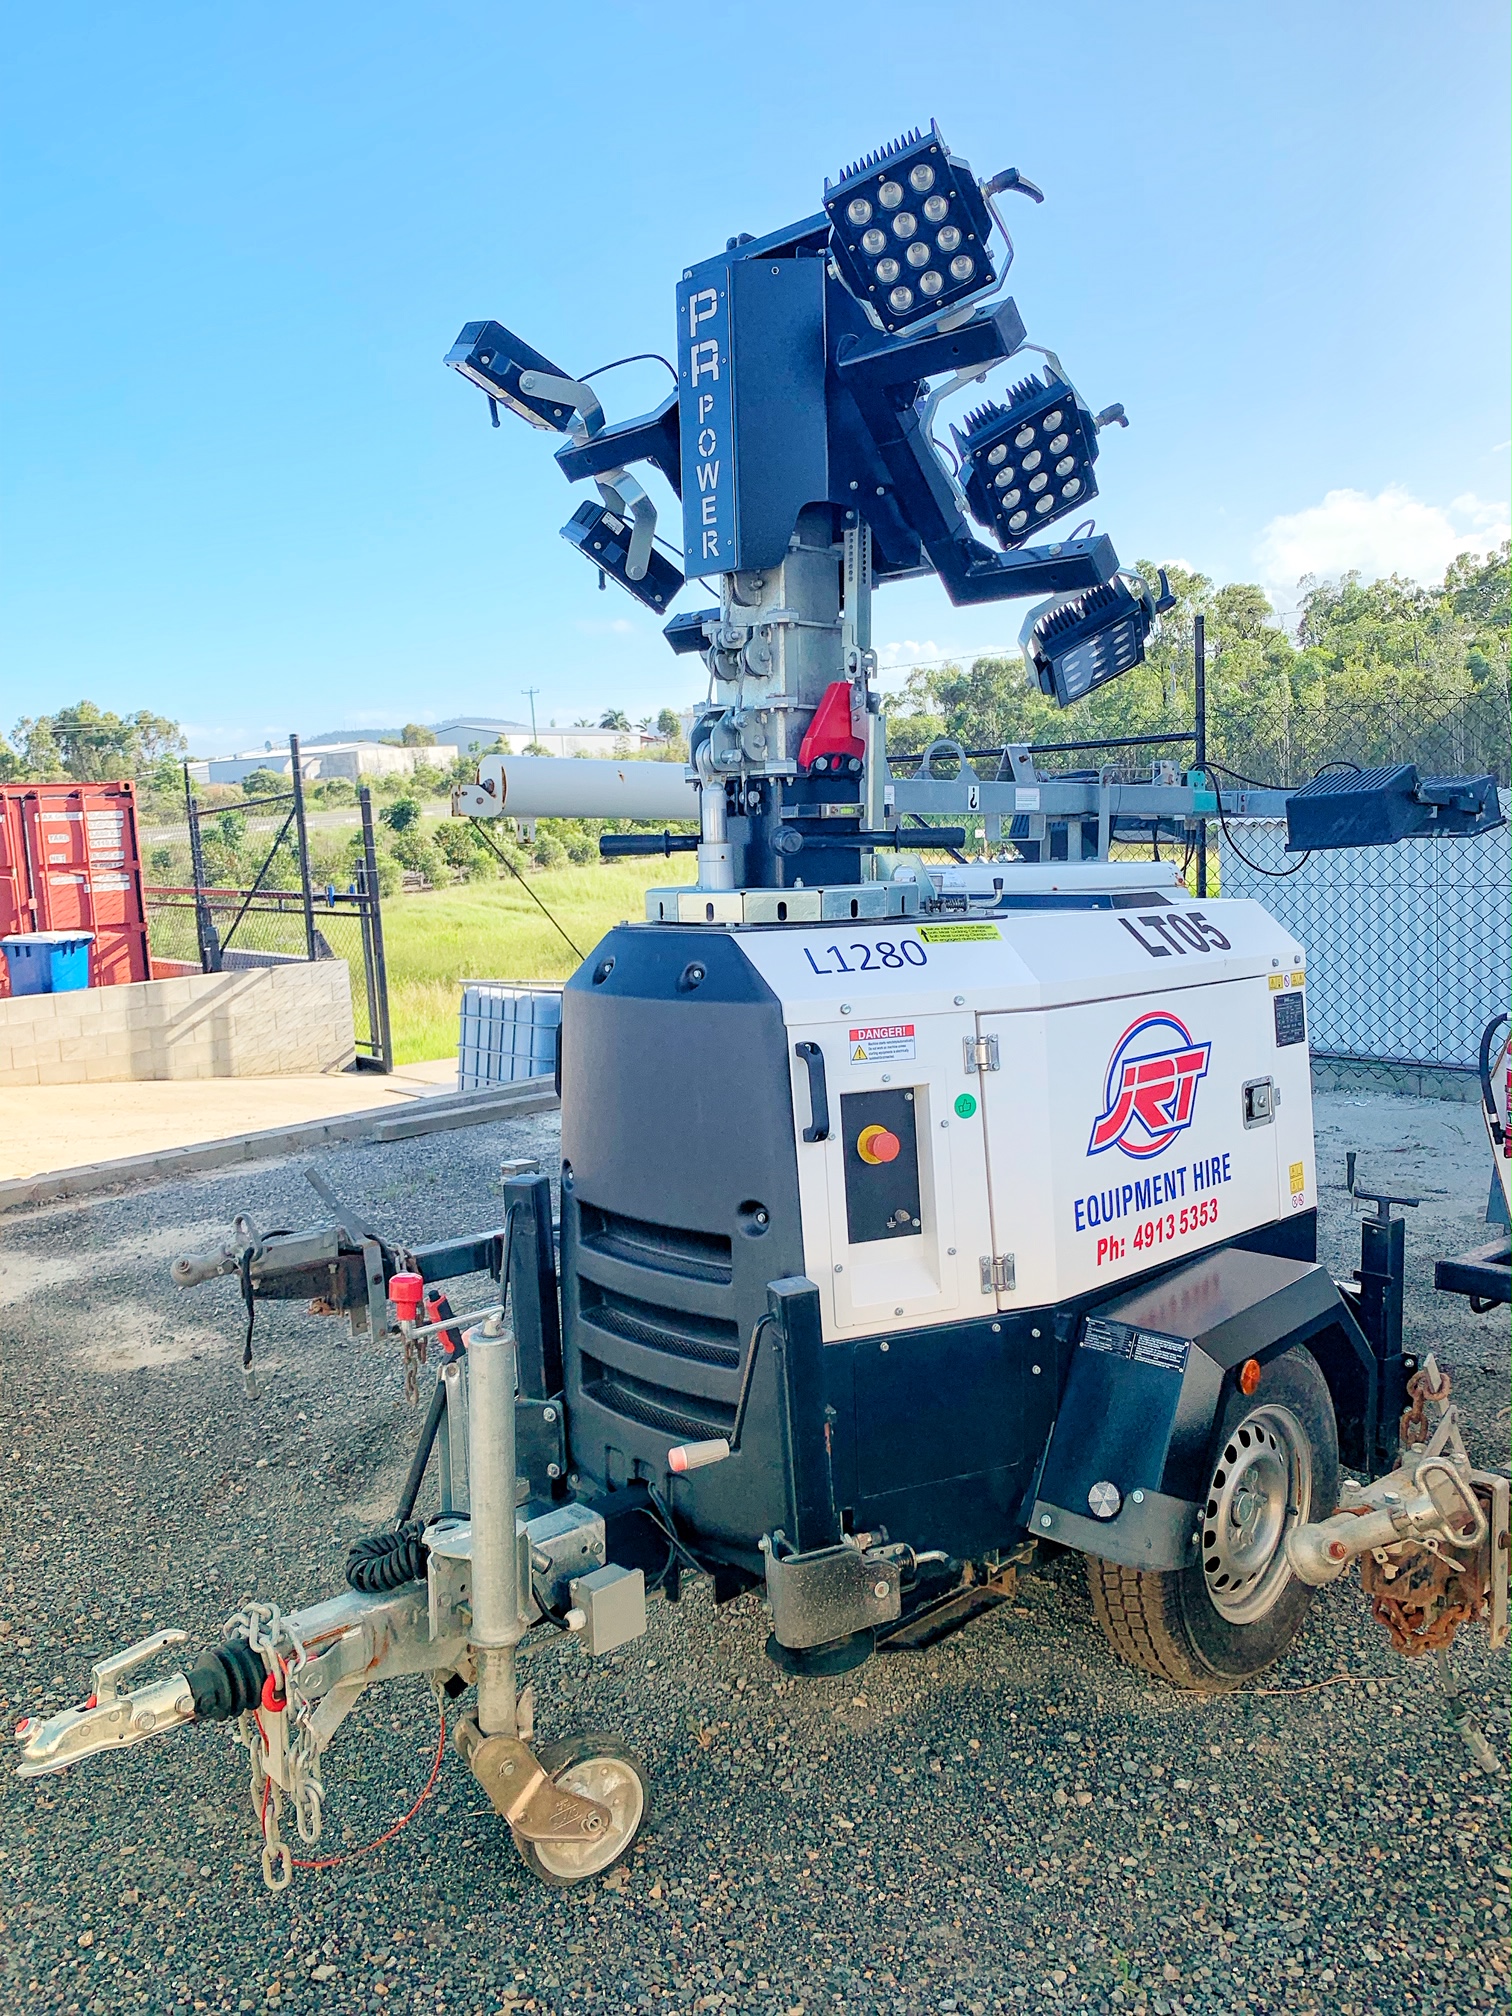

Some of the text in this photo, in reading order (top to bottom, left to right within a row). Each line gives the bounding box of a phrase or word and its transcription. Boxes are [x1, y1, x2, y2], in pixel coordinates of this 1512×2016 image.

[695, 393, 720, 559] POWER
[803, 939, 928, 975] L1280
[1117, 911, 1232, 958] LT05
[858, 1026, 906, 1040] DANGER!
[1074, 1152, 1232, 1232] EQUIPMENT HIRE
[1096, 1198, 1218, 1266] Ph: 4913 5353
